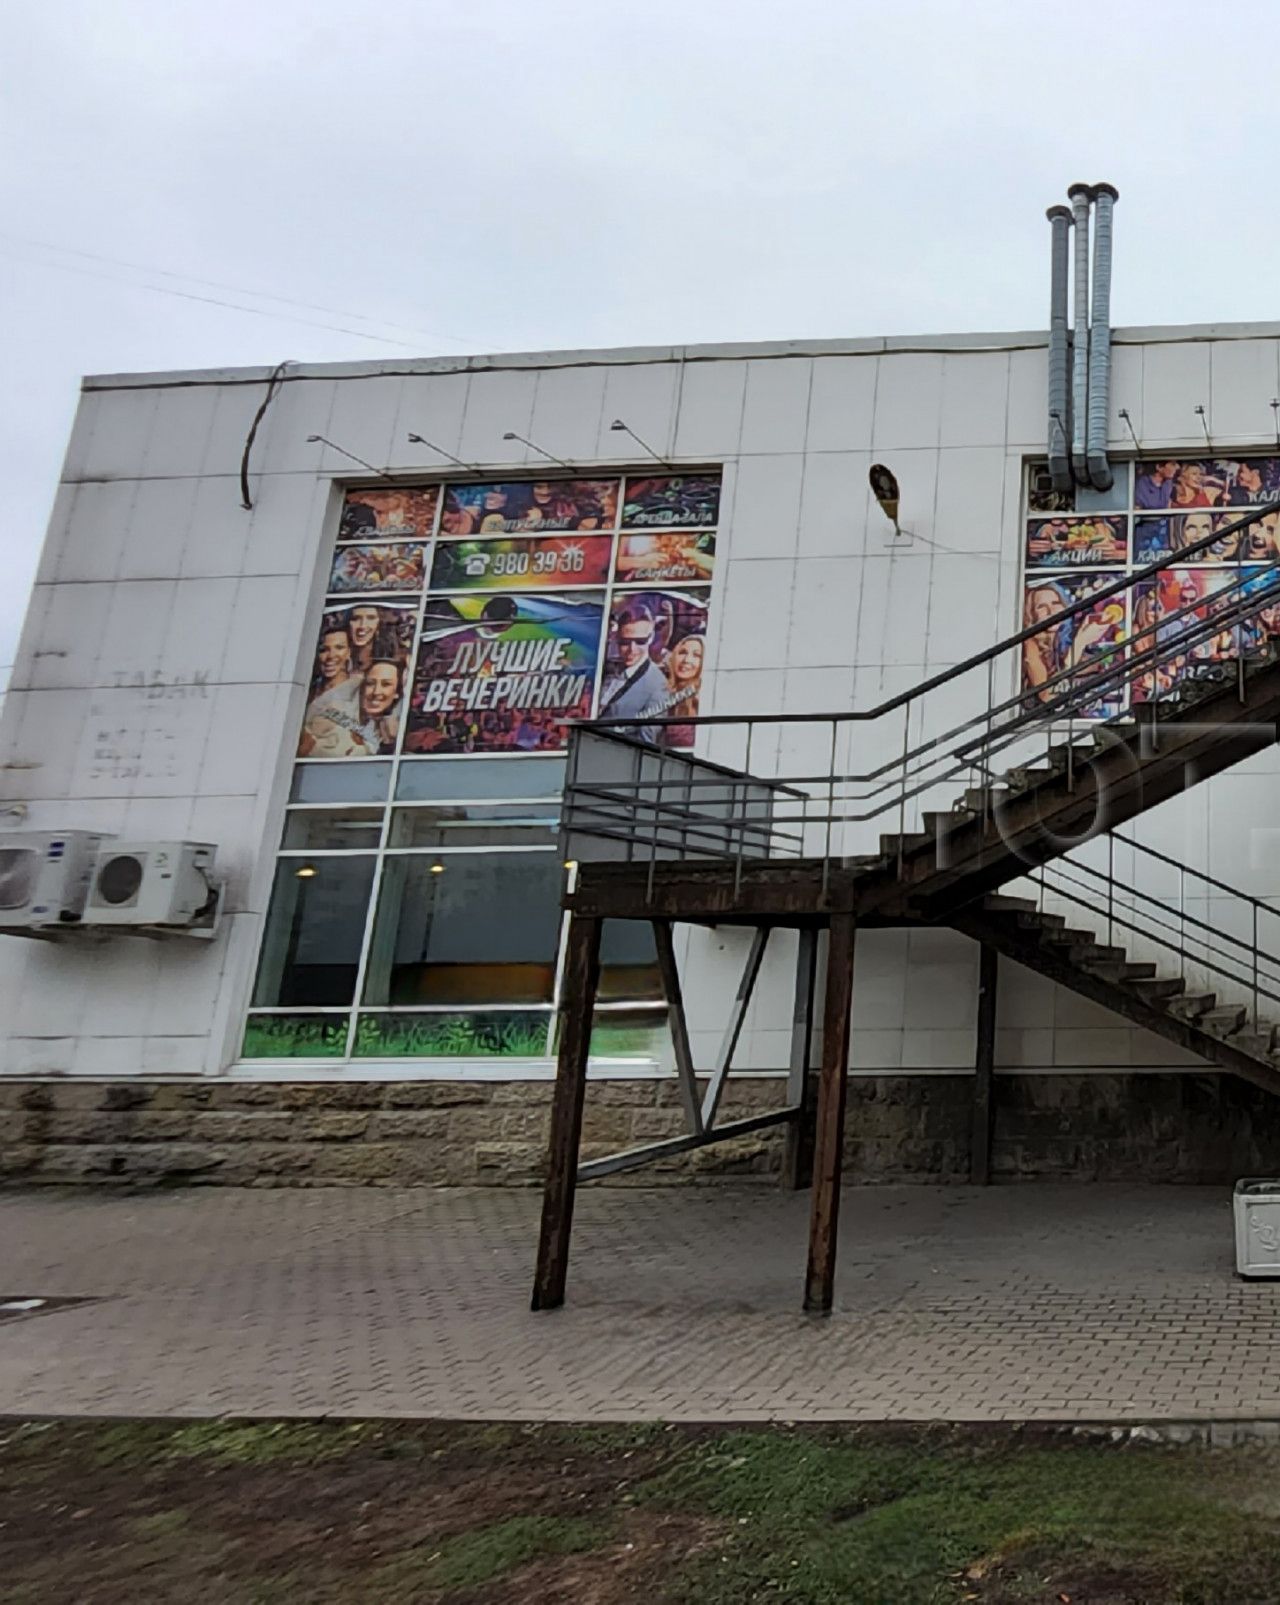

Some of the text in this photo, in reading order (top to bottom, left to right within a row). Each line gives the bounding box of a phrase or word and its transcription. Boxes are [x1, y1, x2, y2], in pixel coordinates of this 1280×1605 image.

[493, 550, 585, 575] 980 39 36
[1050, 549, 1104, 562] АКЦИИ
[447, 638, 572, 675] ЛУЧШИЕ
[423, 674, 586, 712] ВЕЧЕРИНКИ
